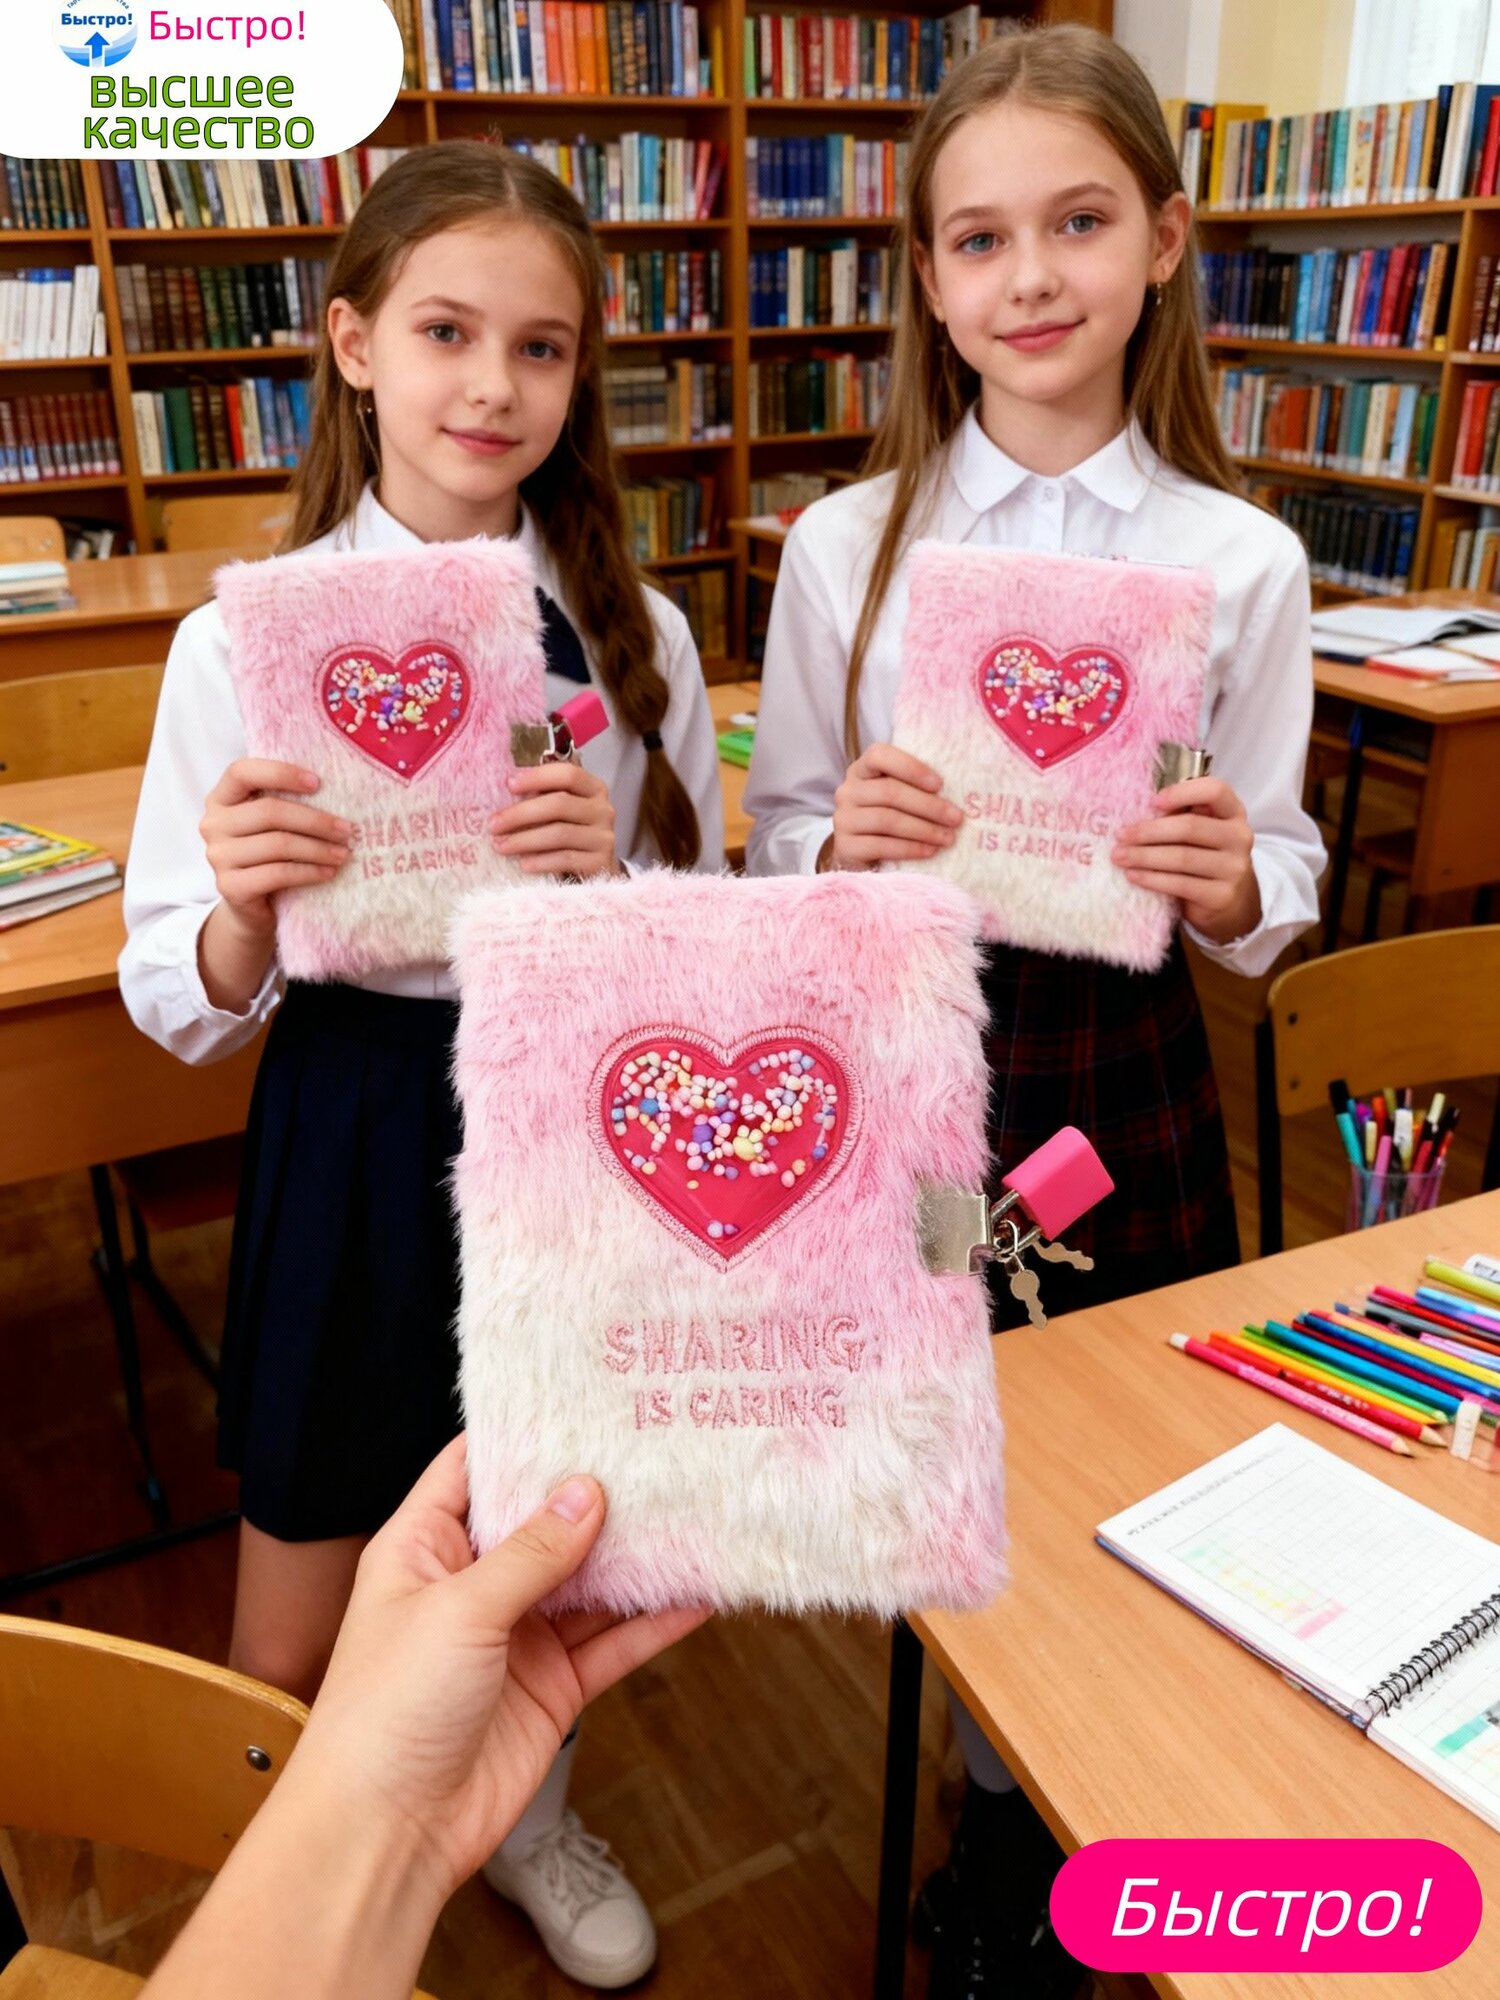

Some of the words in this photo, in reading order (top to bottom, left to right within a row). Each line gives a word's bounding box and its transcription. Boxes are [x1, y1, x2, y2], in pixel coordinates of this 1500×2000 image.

[965, 791, 1111, 837] SHARING
[363, 854, 384, 879] IS
[394, 843, 477, 874] CARING
[977, 830, 998, 852] IS
[1007, 833, 1093, 865] CARING
[603, 1315, 865, 1375] SHARING
[633, 1387, 674, 1429] IS
[689, 1385, 846, 1428] CARING
